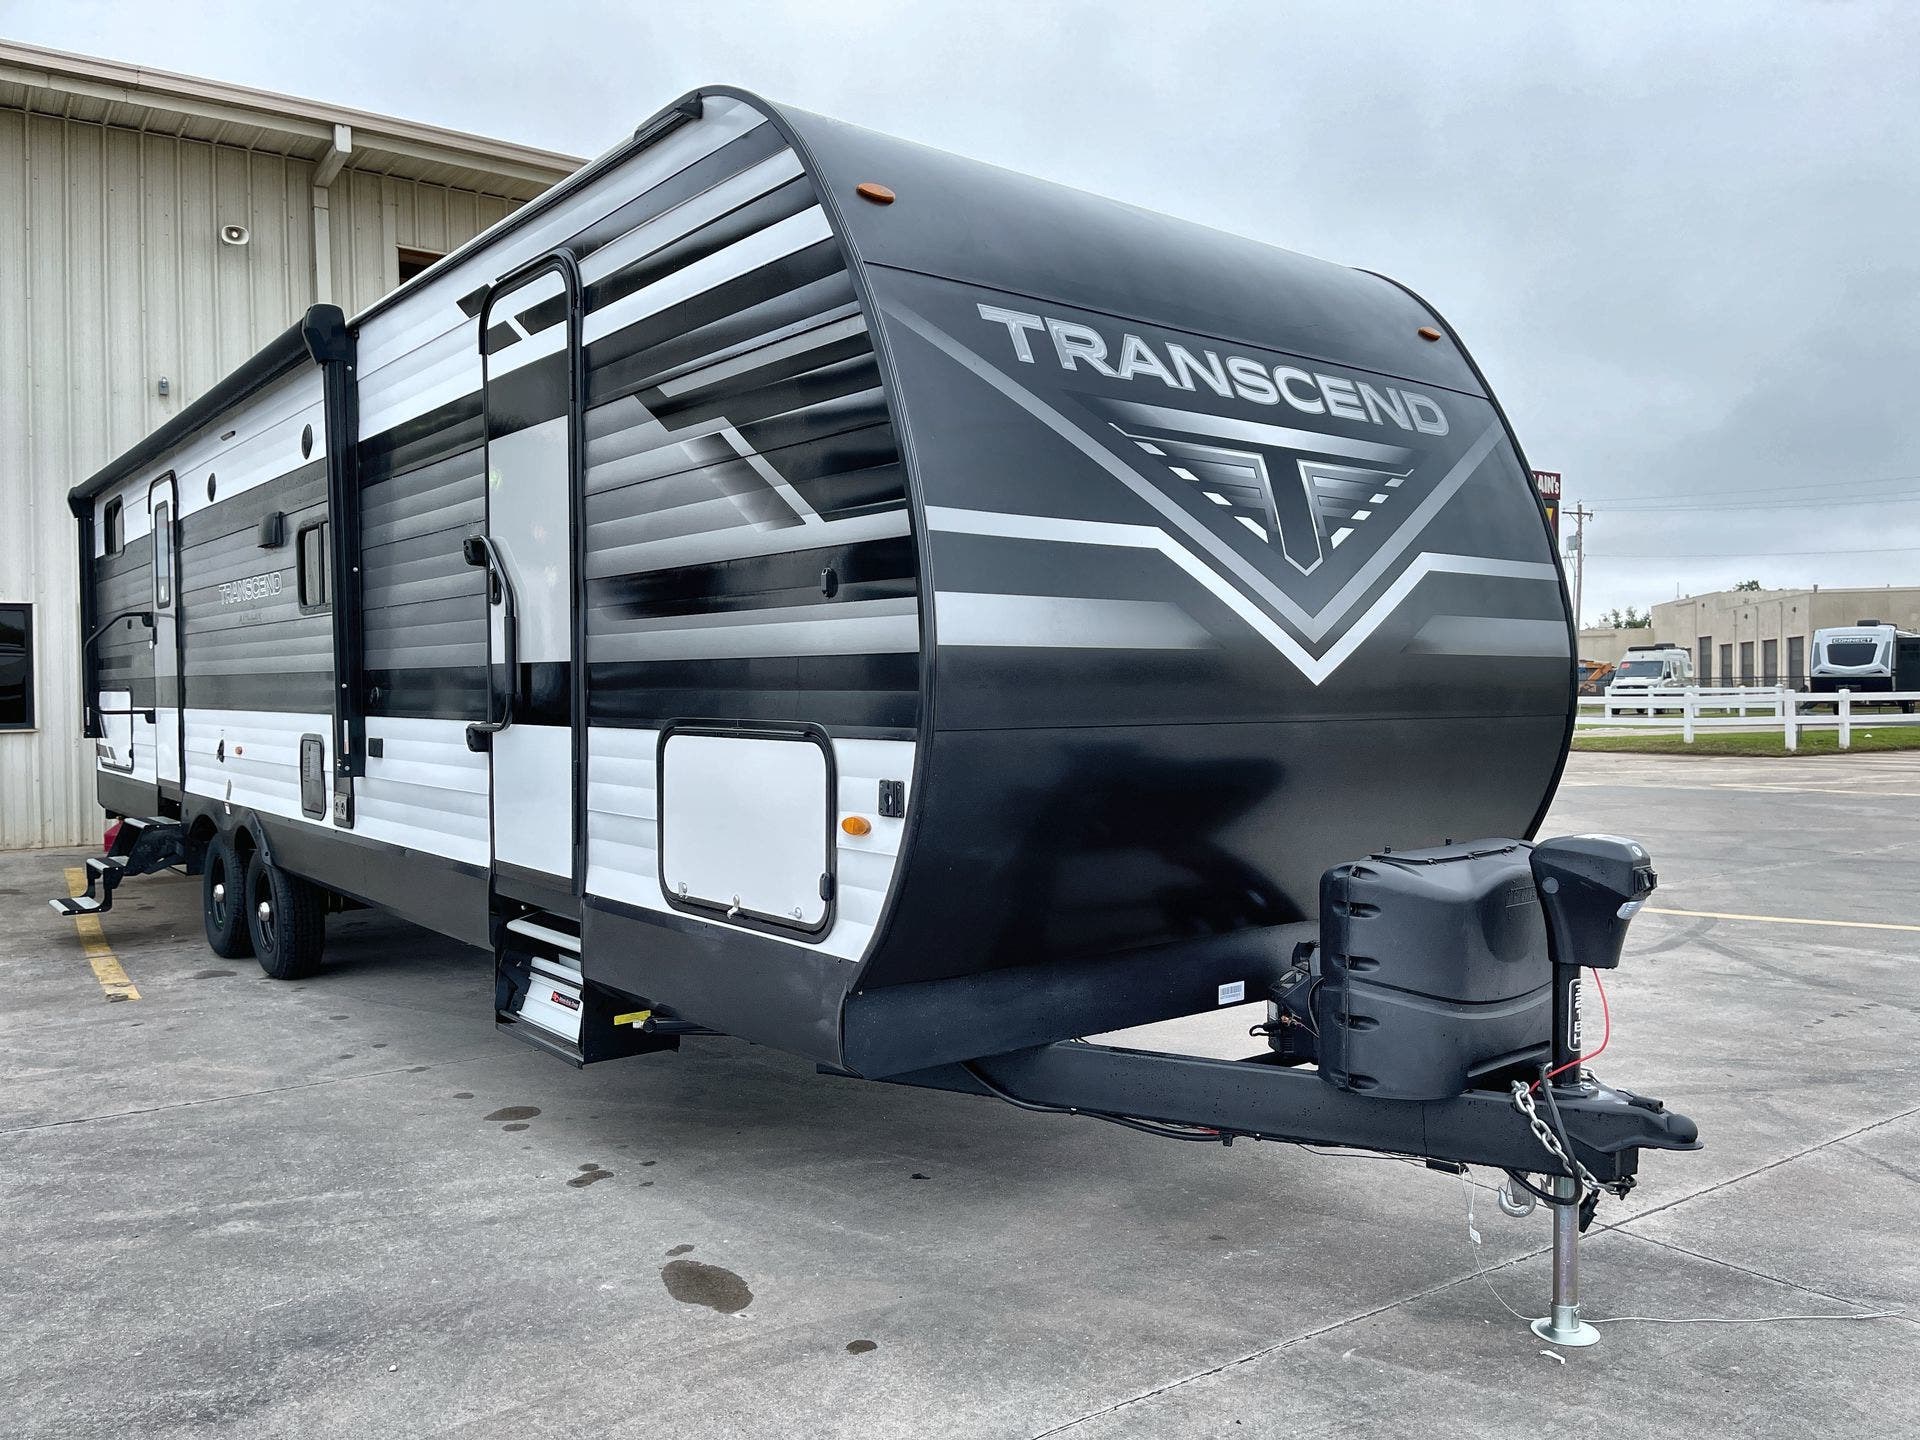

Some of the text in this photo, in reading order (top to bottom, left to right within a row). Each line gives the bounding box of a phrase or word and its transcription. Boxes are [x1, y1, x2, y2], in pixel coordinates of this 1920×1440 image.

[977, 304, 1450, 437] TRANSCEND
[1533, 473, 1560, 495] AIN's
[218, 571, 282, 605] TRANSCEND
